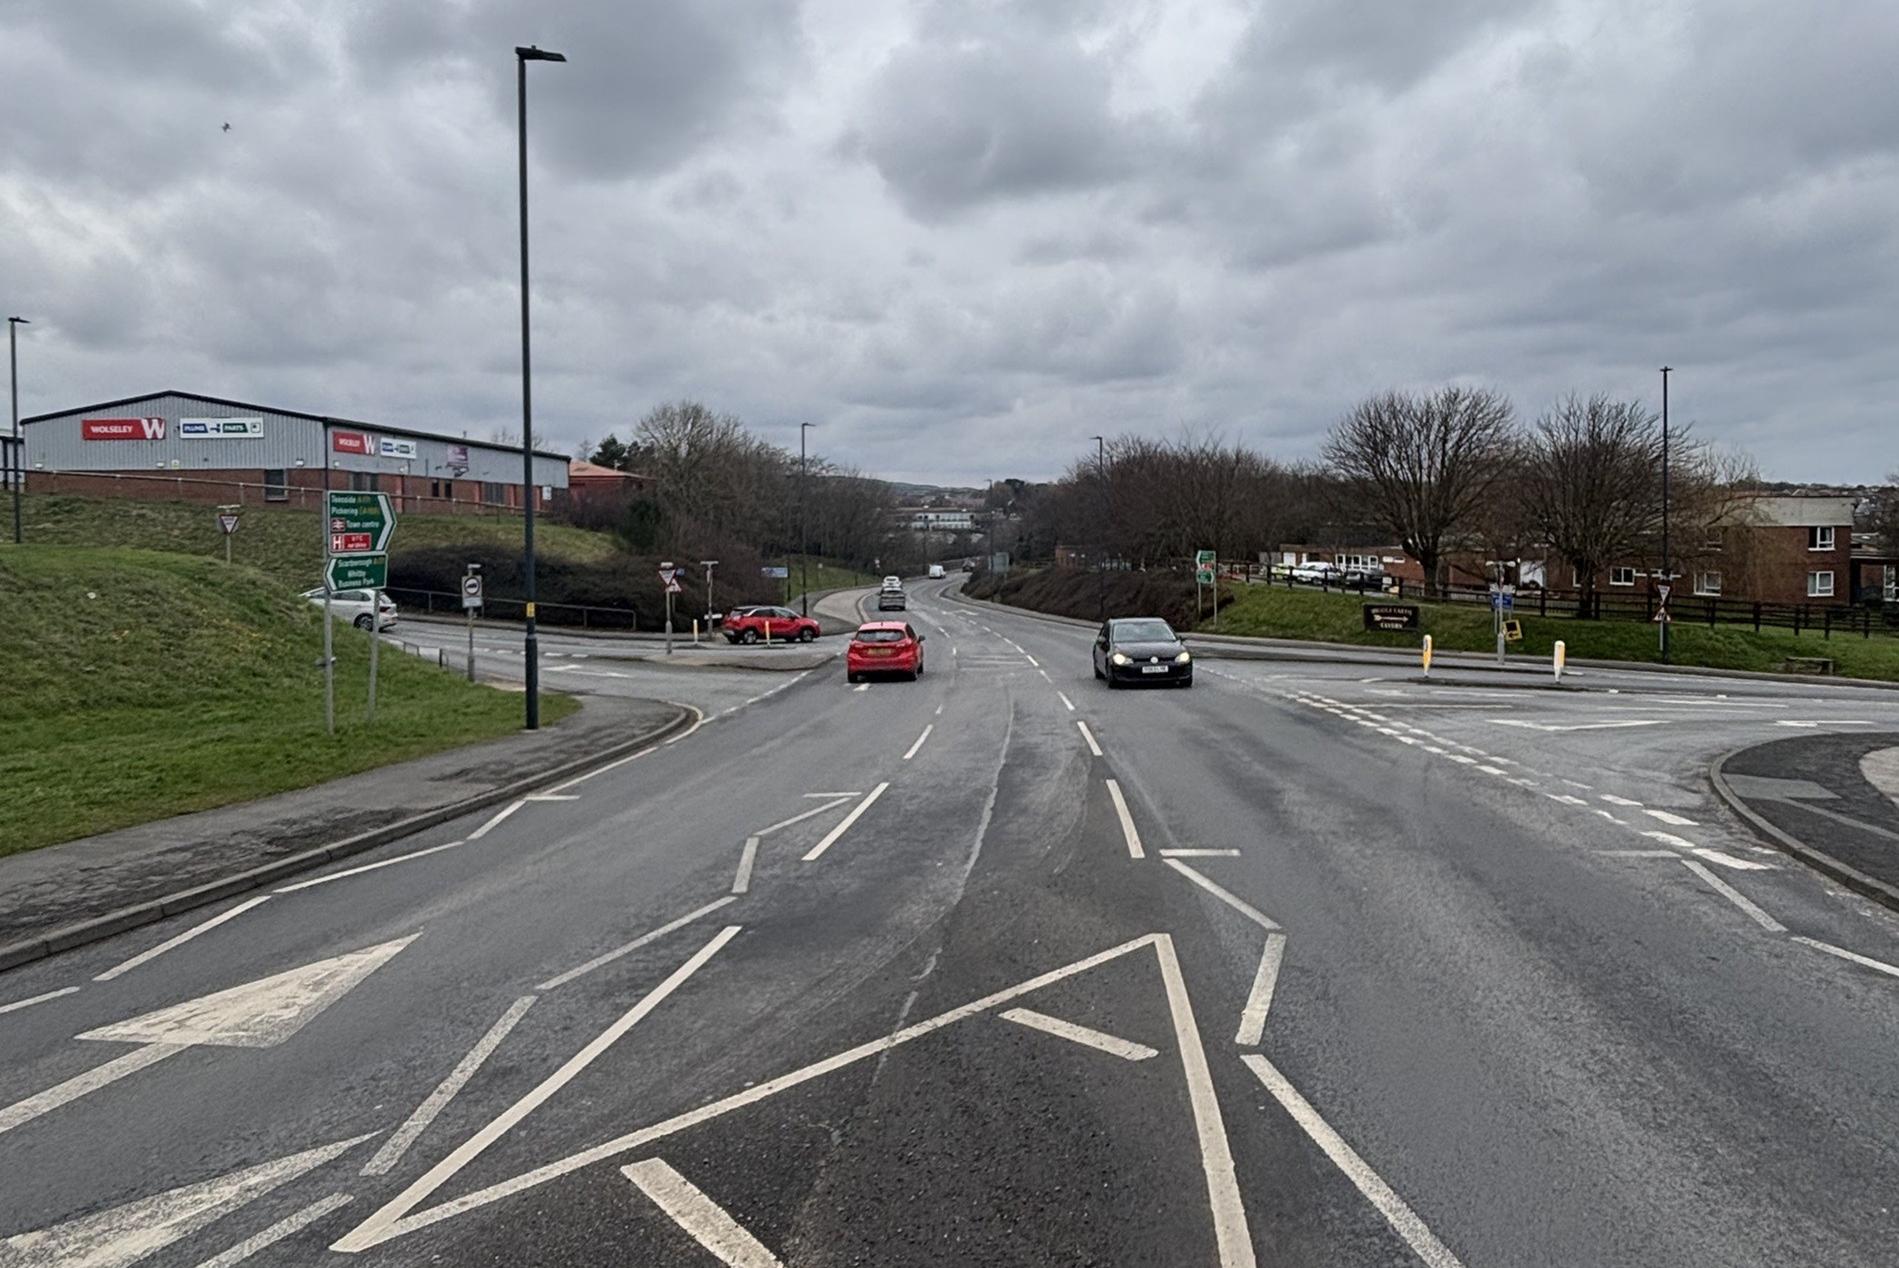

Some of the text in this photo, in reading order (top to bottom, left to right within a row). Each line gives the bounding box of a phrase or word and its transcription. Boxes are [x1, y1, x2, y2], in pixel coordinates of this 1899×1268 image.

[91, 425, 133, 434] WOLSELEY
[346, 520, 380, 529] Town centre
[337, 558, 373, 568] Scarborough
